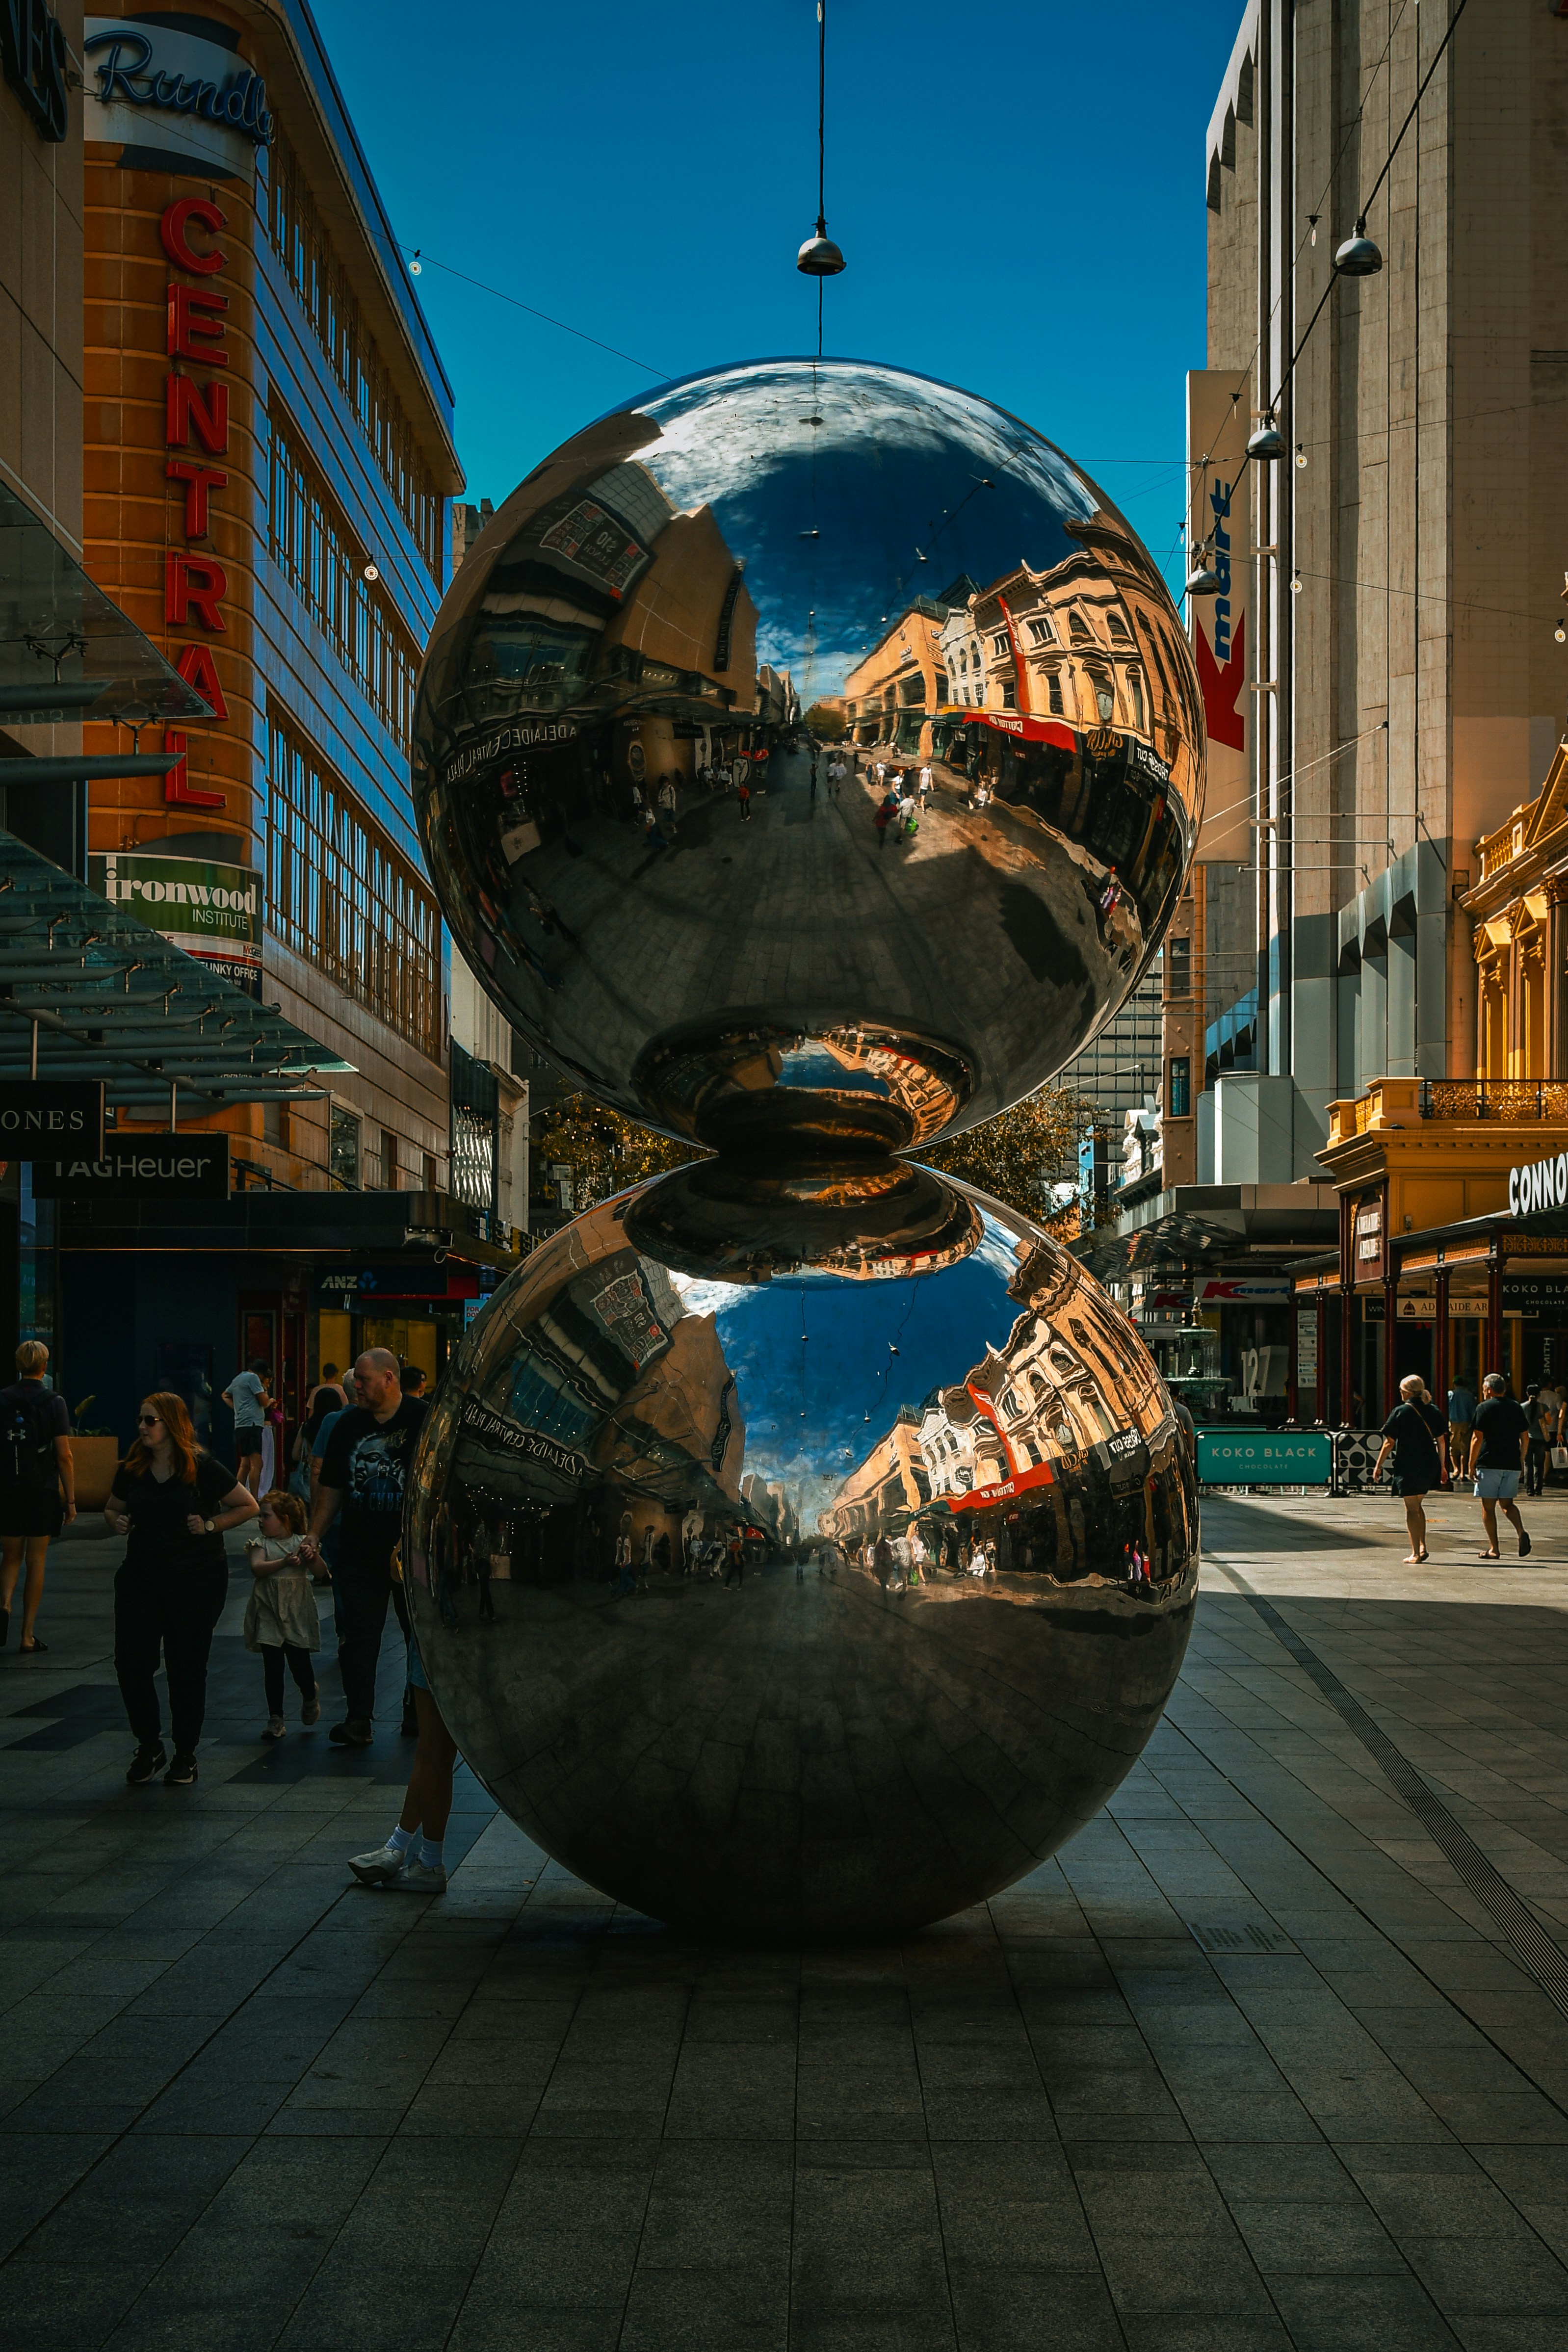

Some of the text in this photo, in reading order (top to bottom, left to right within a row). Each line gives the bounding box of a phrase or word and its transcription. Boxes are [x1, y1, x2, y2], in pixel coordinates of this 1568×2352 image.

[83, 30, 276, 146] Rundle
[160, 198, 230, 809] CENTRAL
[104, 867, 257, 915] ironwood
[193, 909, 248, 930] INSTITUTE
[234, 966, 258, 981] OFFICE
[1, 1110, 84, 1129] ONES
[1509, 1152, 1568, 1216] CONNO
[321, 1276, 357, 1289] ANZ
[1202, 1281, 1290, 1299] Kmart
[1503, 1285, 1538, 1293] KOKO
[1212, 1448, 1316, 1457] KOKO BLACK
